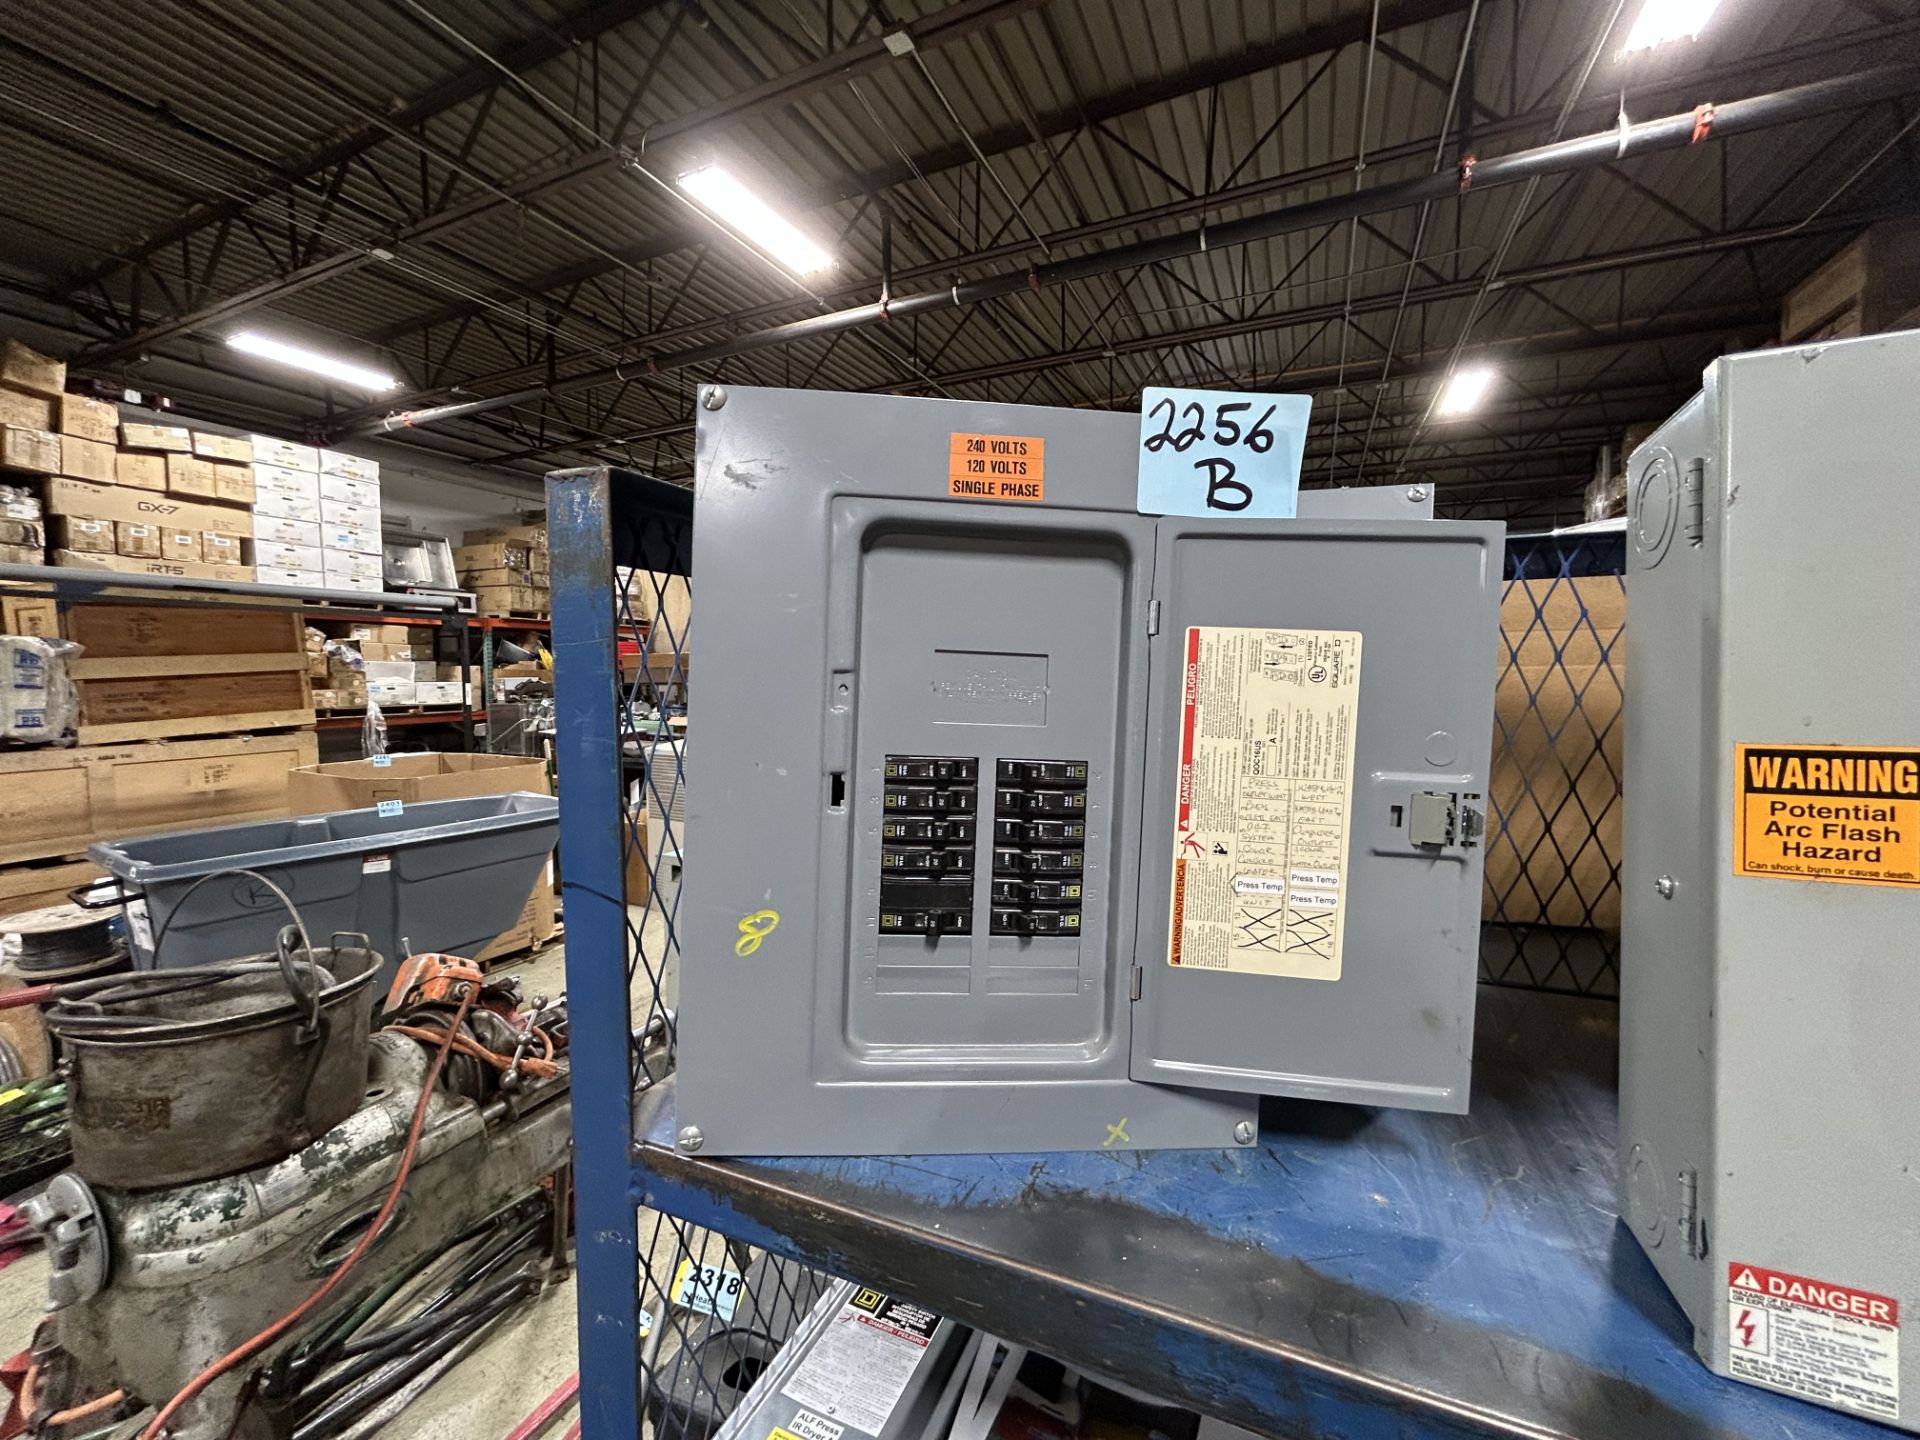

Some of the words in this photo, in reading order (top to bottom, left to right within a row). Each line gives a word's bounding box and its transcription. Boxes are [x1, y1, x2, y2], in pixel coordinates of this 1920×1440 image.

[1144, 398, 1277, 453] 2256
[967, 439, 985, 453] 240
[991, 440, 1027, 455] VOLTS
[967, 459, 985, 473] 120
[991, 460, 1027, 475] VOLTS
[953, 480, 995, 495] SINGLE
[1001, 483, 1039, 497] PHASE
[1194, 457, 1254, 511] B
[138, 501, 179, 515] GX-7
[1311, 669, 1324, 679] UL
[1332, 651, 1340, 688] SQUARE
[1186, 663, 1197, 705] PELIGRO
[1252, 741, 1262, 775] QOC16US
[1180, 764, 1191, 804] DANGER
[1749, 756, 1918, 794] WARNING
[1770, 800, 1896, 822] Potential
[1764, 821, 1813, 838] Arc
[1822, 823, 1901, 843] Flash
[1783, 841, 1881, 863] Hazard
[1292, 874, 1313, 882] Press
[1316, 876, 1338, 884] Temp
[1748, 861, 1768, 870] Can
[1771, 863, 1804, 873] shock,
[1807, 865, 1833, 875] burn
[1834, 868, 1846, 876] or
[1848, 869, 1880, 878] cause
[1238, 881, 1259, 889] Press
[1261, 883, 1283, 891] Temp
[1173, 863, 1185, 954] WARNING/ADVERTENCIA
[1291, 895, 1312, 903] Press
[1314, 896, 1337, 904] Temp
[1732, 1289, 1765, 1300] HAZARD
[1746, 1297, 1792, 1313] EXPLOSION
[1768, 1276, 1890, 1320] DANGER
[868, 1319, 893, 1333] DANGER
[897, 1331, 925, 1344] PELIGRO
[792, 1422, 803, 1431] IR
[802, 1426, 825, 1440] Dryer
[798, 1413, 816, 1424] ALF
[816, 1420, 840, 1436] Press
